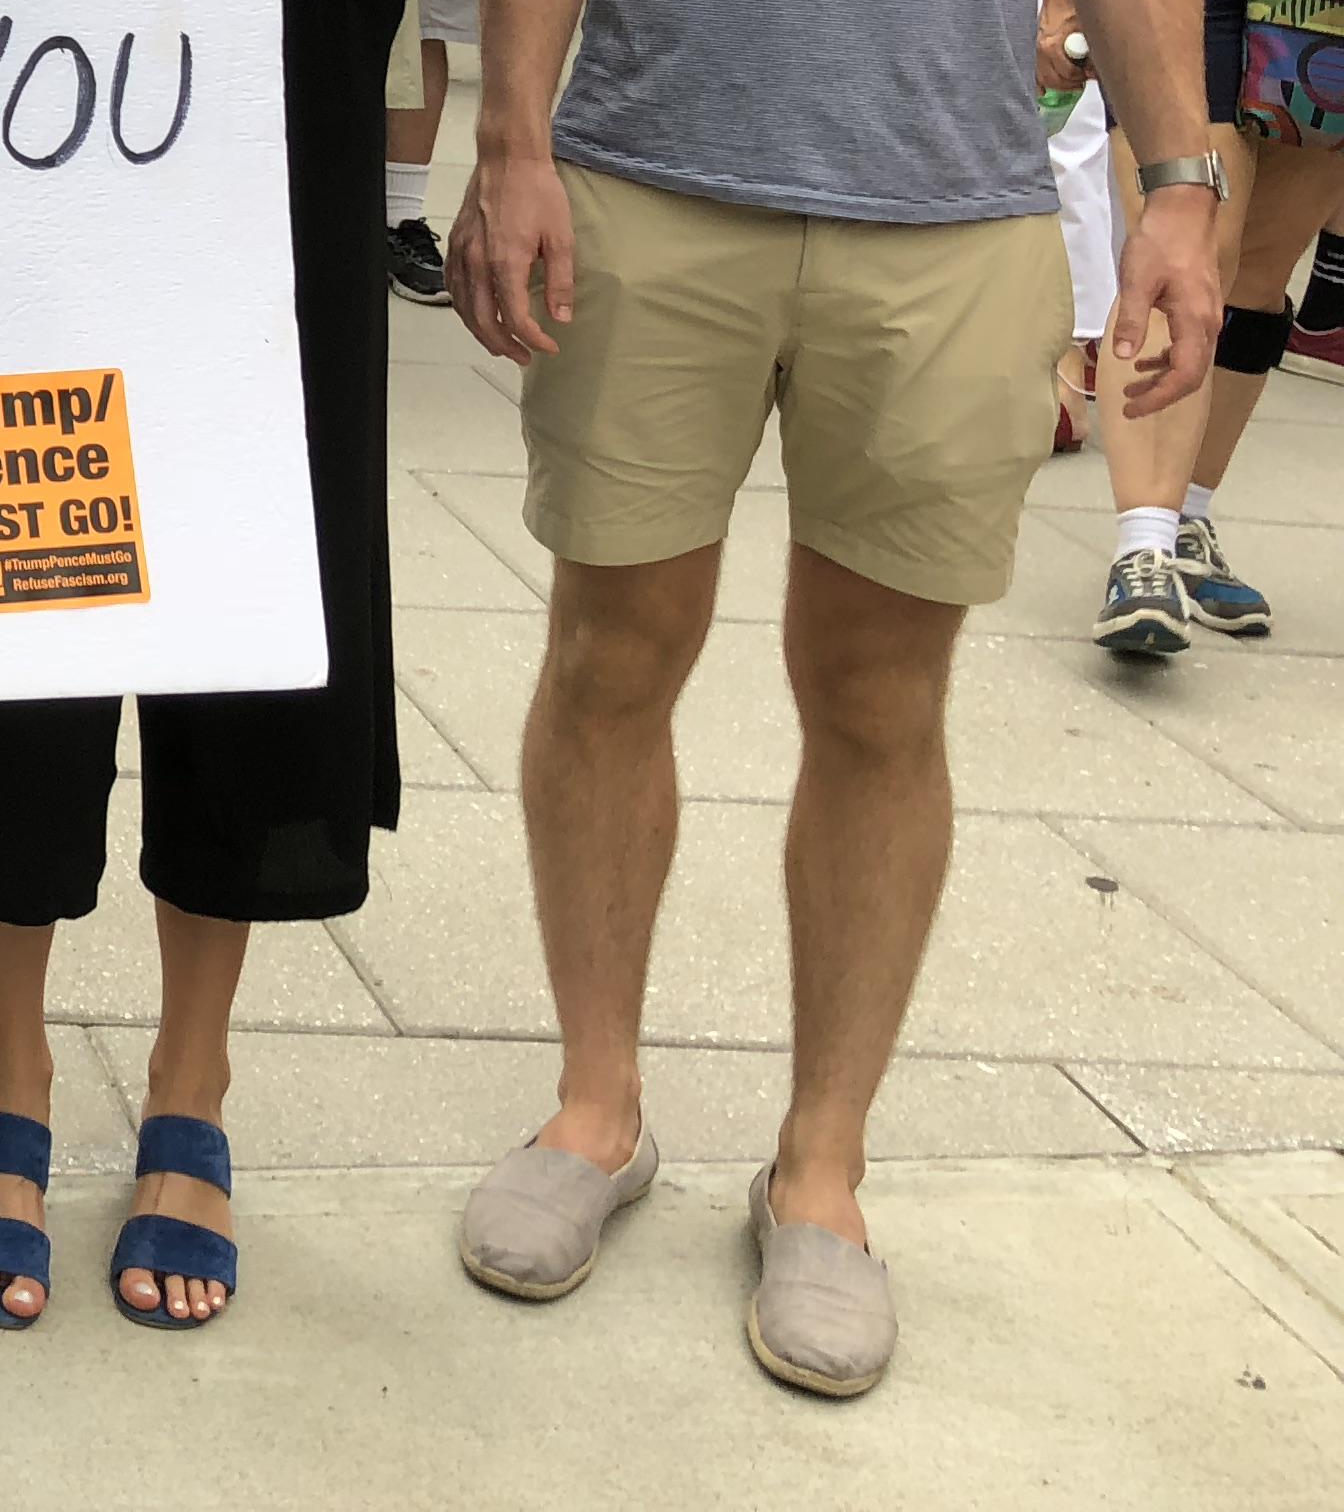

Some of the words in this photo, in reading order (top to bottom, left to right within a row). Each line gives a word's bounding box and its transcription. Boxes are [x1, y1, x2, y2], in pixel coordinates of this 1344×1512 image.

[59, 495, 134, 537] GO!
[4, 550, 132, 572] #TrumpPenceMustGo
[12, 572, 129, 591] RefuseFascism.org
